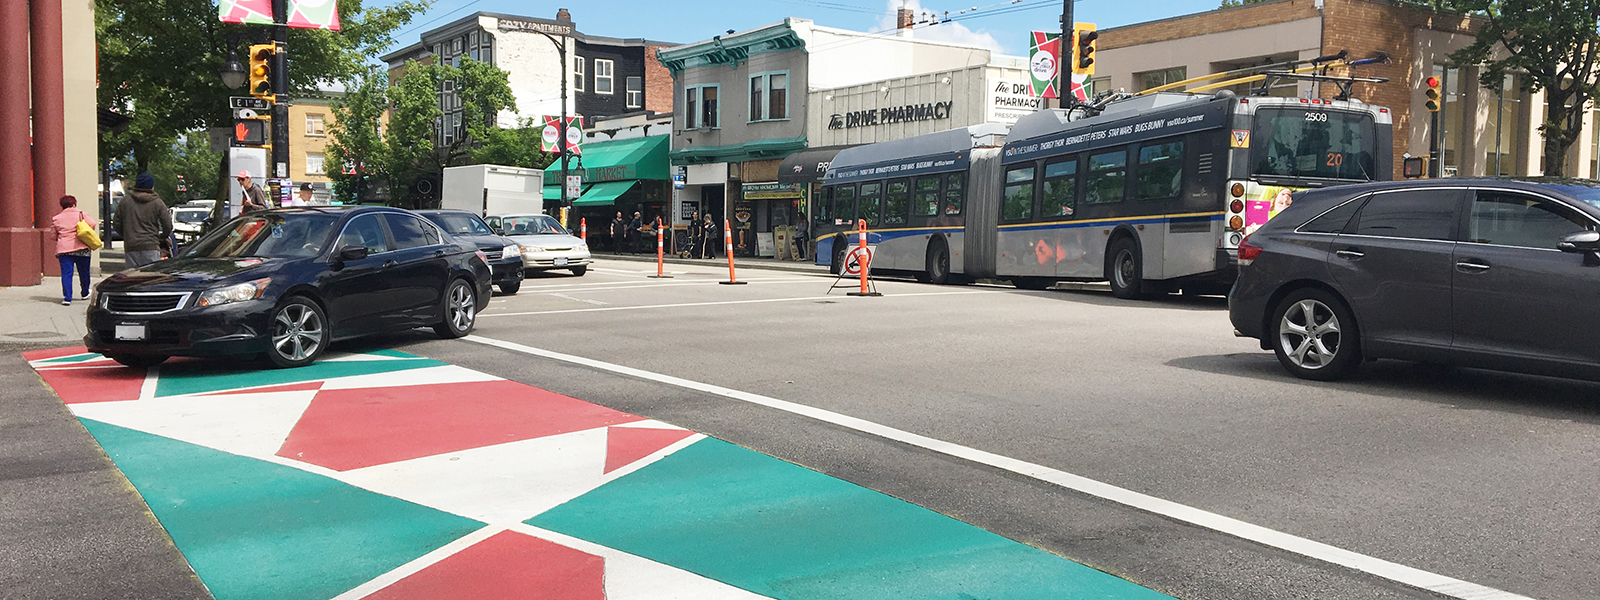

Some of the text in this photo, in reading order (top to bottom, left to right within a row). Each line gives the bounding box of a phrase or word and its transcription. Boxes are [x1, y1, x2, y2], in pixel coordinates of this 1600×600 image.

[527, 22, 571, 34] APARTMENTS
[995, 81, 1029, 95] The DRI
[236, 98, 242, 107] E
[995, 96, 1041, 109] PHARMACY
[828, 100, 953, 130] The DRIVE PHARMACY
[1304, 111, 1328, 123] 2509
[1054, 138, 1064, 148] THOR
[1066, 133, 1090, 146] BERNADETTE
[1090, 130, 1107, 140] PETERS
[1108, 127, 1119, 138] STAR
[1119, 125, 1133, 136] WARS
[1135, 122, 1148, 133] BUGS
[1148, 119, 1165, 131] BUNNY
[1167, 114, 1204, 127] vso100.ca/summer
[1326, 152, 1342, 166] 20
[595, 165, 626, 181] MARKET
